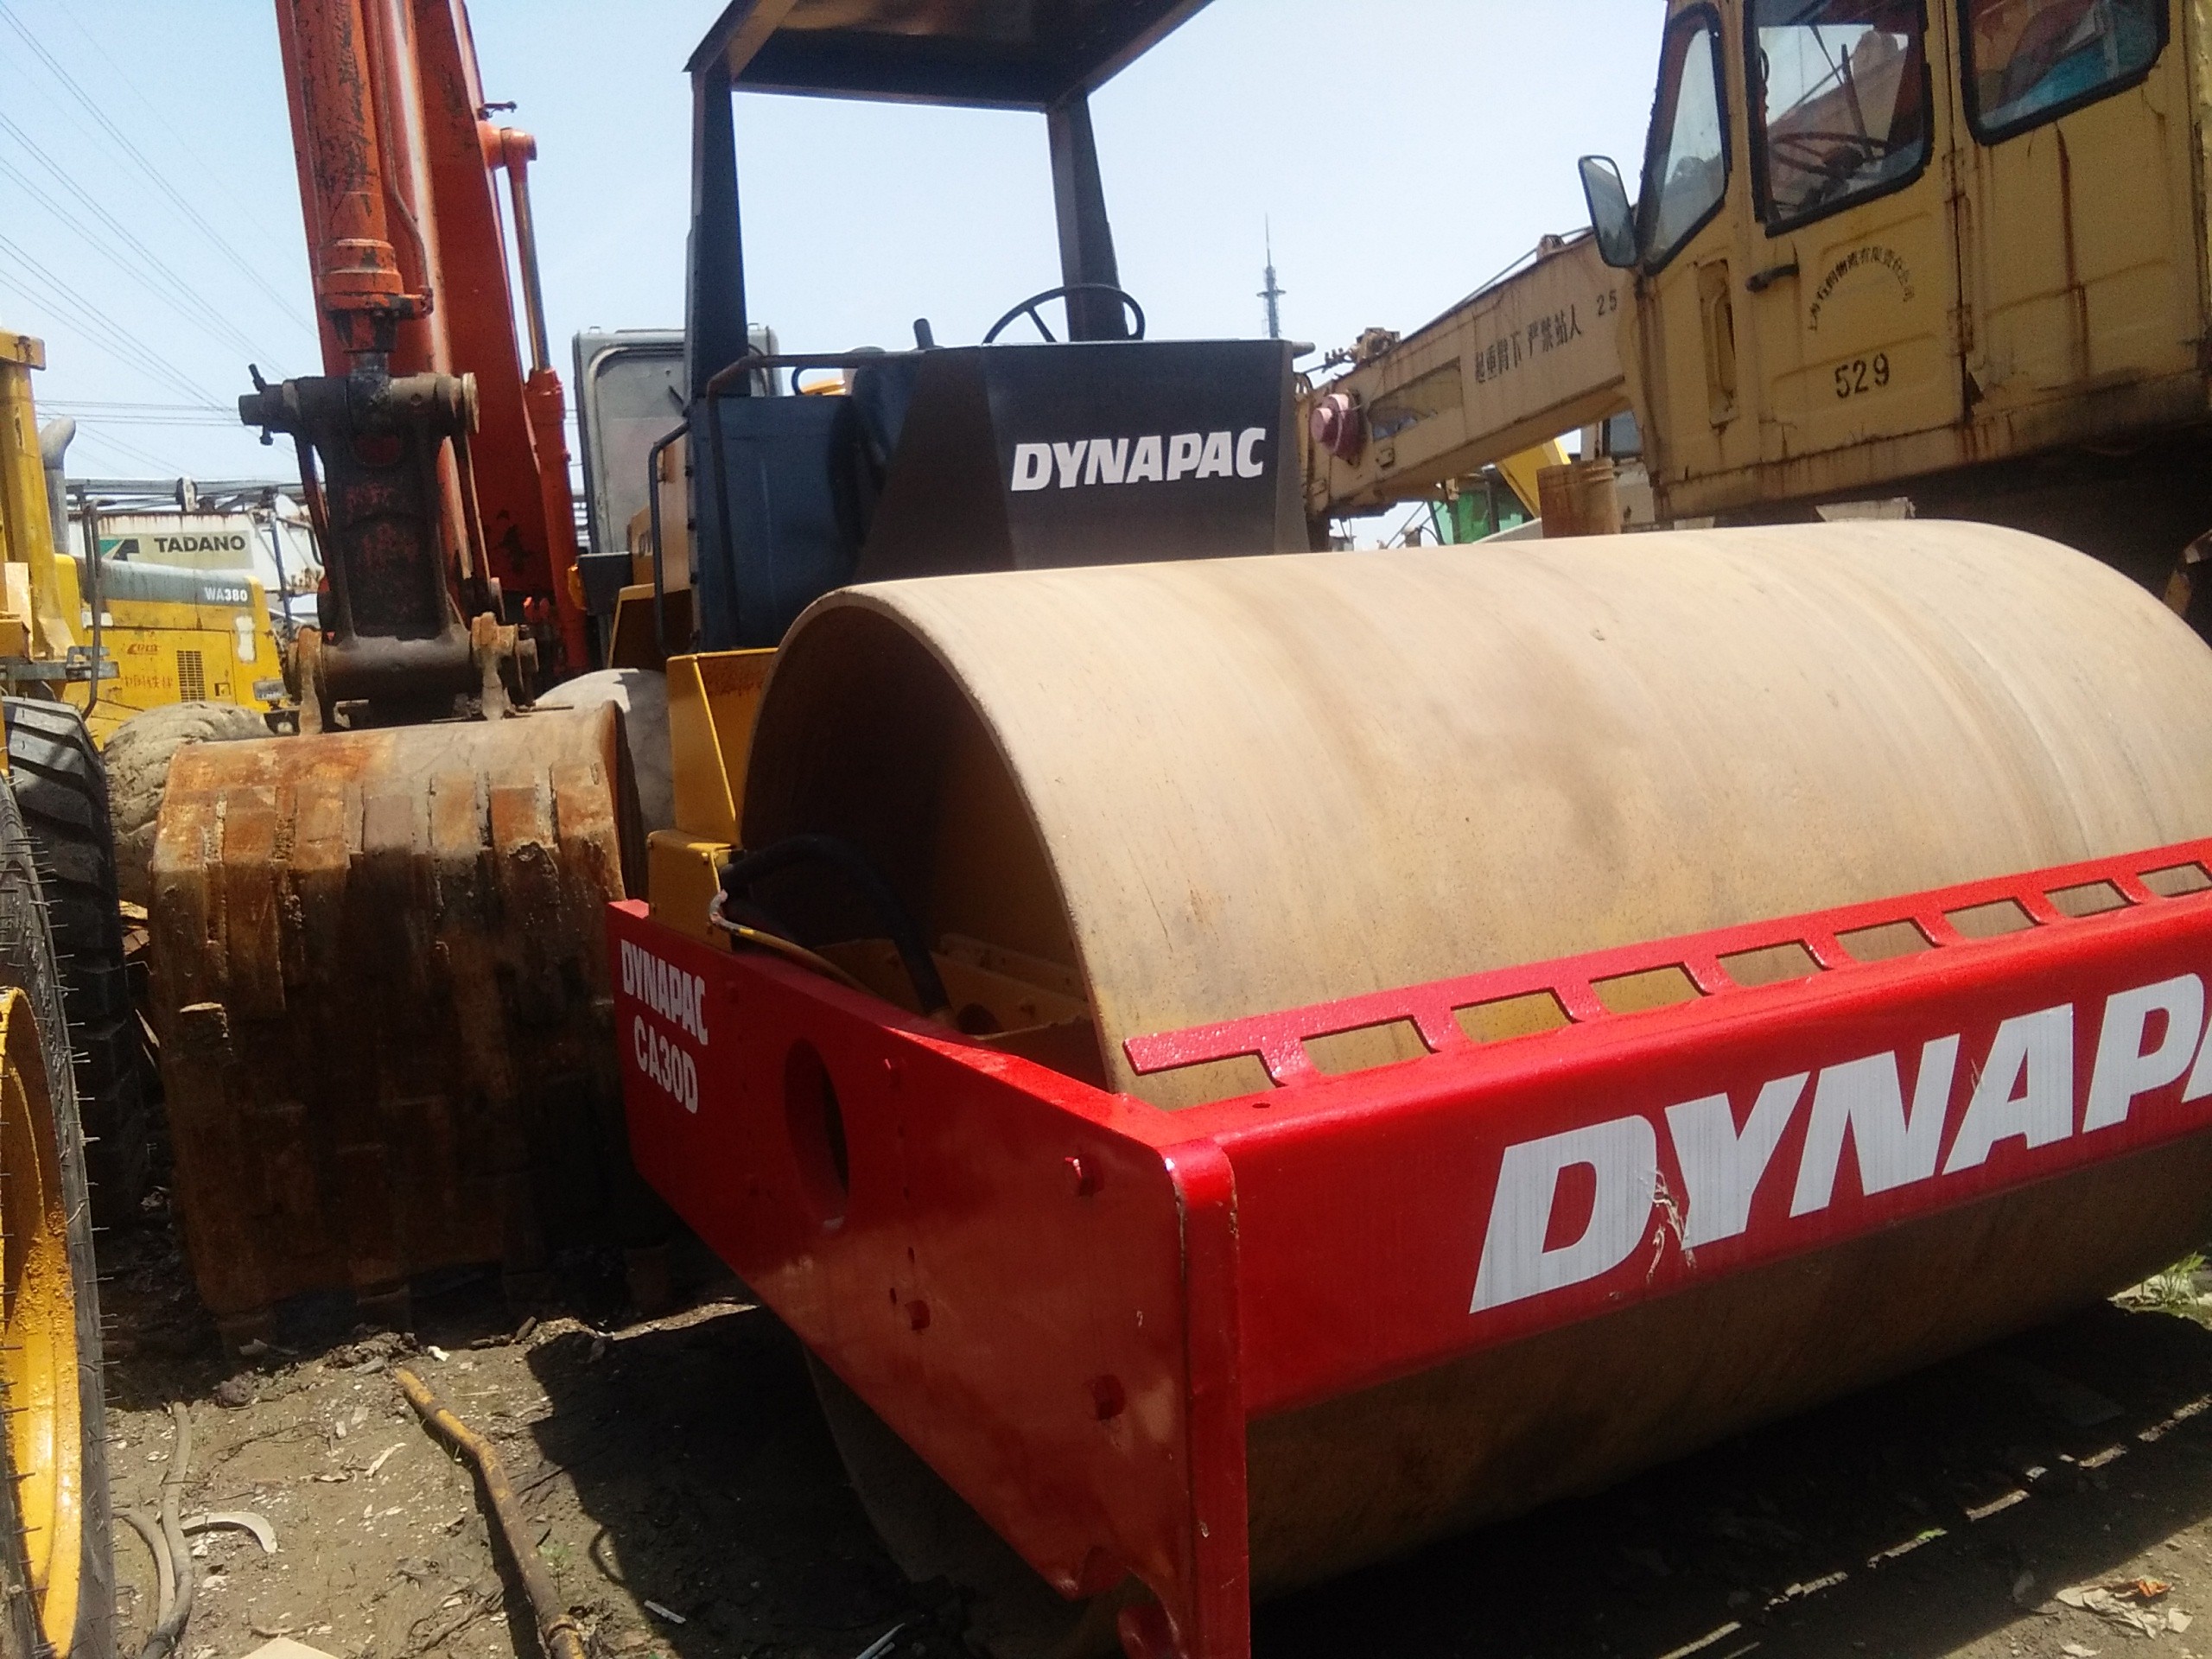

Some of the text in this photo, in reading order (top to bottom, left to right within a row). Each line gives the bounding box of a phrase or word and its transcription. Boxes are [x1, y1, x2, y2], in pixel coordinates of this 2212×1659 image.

[1596, 289, 1618, 315] 25
[1835, 353, 1890, 398] 529
[1011, 428, 1267, 492] DYNAPAC
[154, 536, 245, 553] TADANO
[204, 587, 248, 602] WA380
[620, 939, 709, 1046] DYNAPAC
[633, 1014, 699, 1115] CA30D
